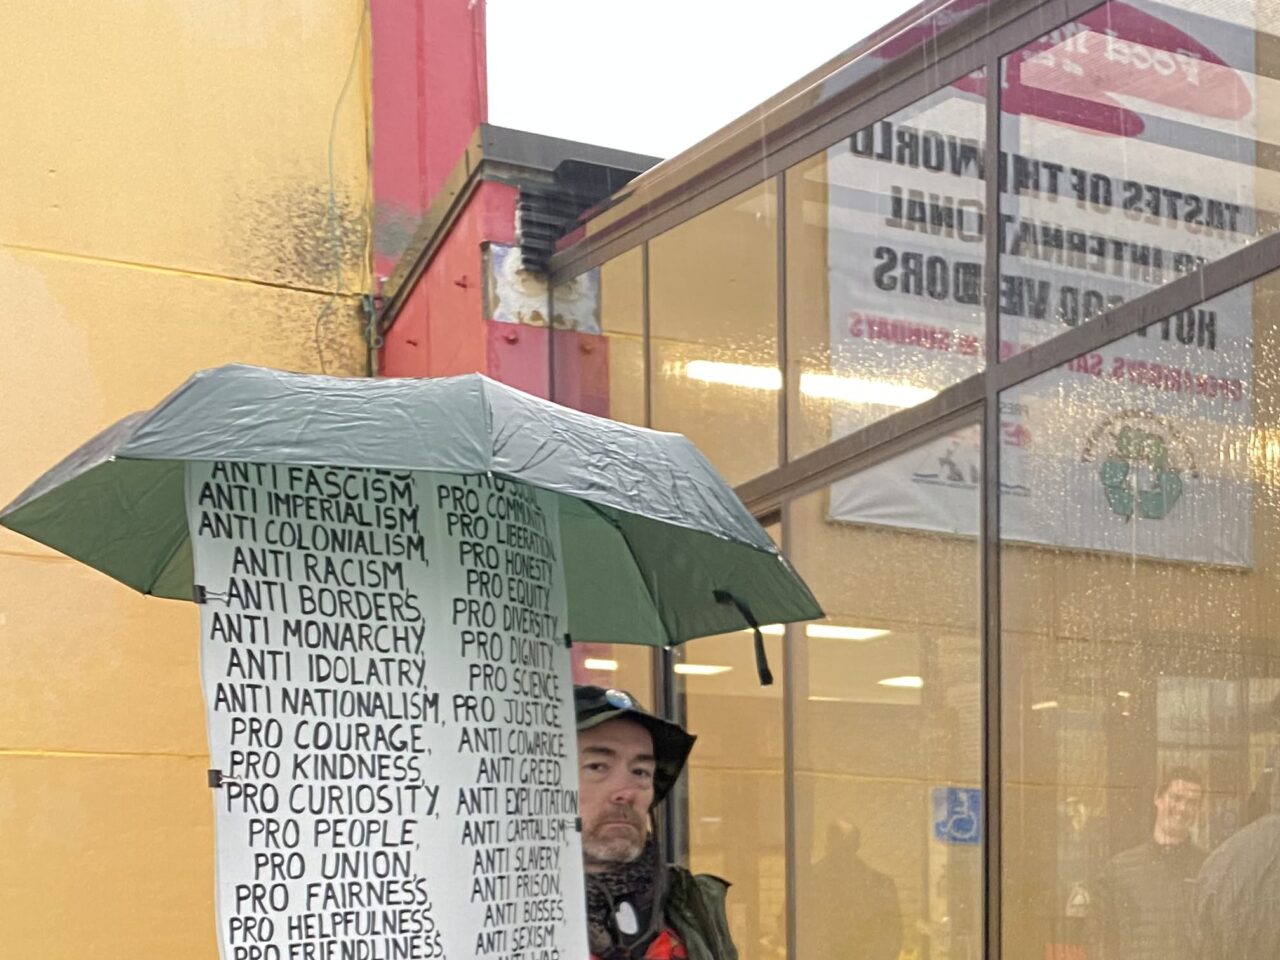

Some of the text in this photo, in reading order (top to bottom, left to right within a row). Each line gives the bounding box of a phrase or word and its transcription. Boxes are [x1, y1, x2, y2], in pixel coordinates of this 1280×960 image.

[211, 461, 277, 490] ANTI
[198, 481, 258, 514] ANTI
[437, 485, 479, 514] PRO
[198, 511, 429, 567] ANTI COLONIALISM,
[446, 512, 489, 540] PRO
[459, 541, 500, 570] PRO
[231, 546, 410, 596] ANTI RACISM,
[466, 569, 503, 599] PRO
[226, 576, 427, 626] ANTI BORDERS,
[452, 598, 497, 628] PRO
[210, 611, 426, 657] ANTI MONARCHY,
[460, 630, 503, 662] PRO
[226, 647, 428, 691] ANTI IDOLATRY,
[469, 664, 508, 692] PRO
[213, 682, 446, 728] ANTI NATIONALISM,
[452, 694, 496, 722] PRO
[230, 717, 432, 757] PRO COURAGE,
[457, 726, 502, 754] ANTI
[229, 750, 426, 787] PRO KINDNESS,
[475, 757, 515, 784] ANTI
[227, 783, 441, 820] PRO CURIOSITY,
[456, 786, 499, 816] ANTI
[248, 818, 420, 851] PRO PEOPLE,
[461, 819, 570, 847] ANTI CAPITALISM,
[254, 850, 418, 882] PRO UNION,
[472, 848, 510, 876] ANTI
[235, 877, 433, 915] PRO FAIRNESS,
[470, 874, 511, 903] ANTI
[229, 908, 440, 945] PRO HELPFULNESS,
[483, 902, 517, 928] ANTI
[474, 930, 508, 956] ANTI
